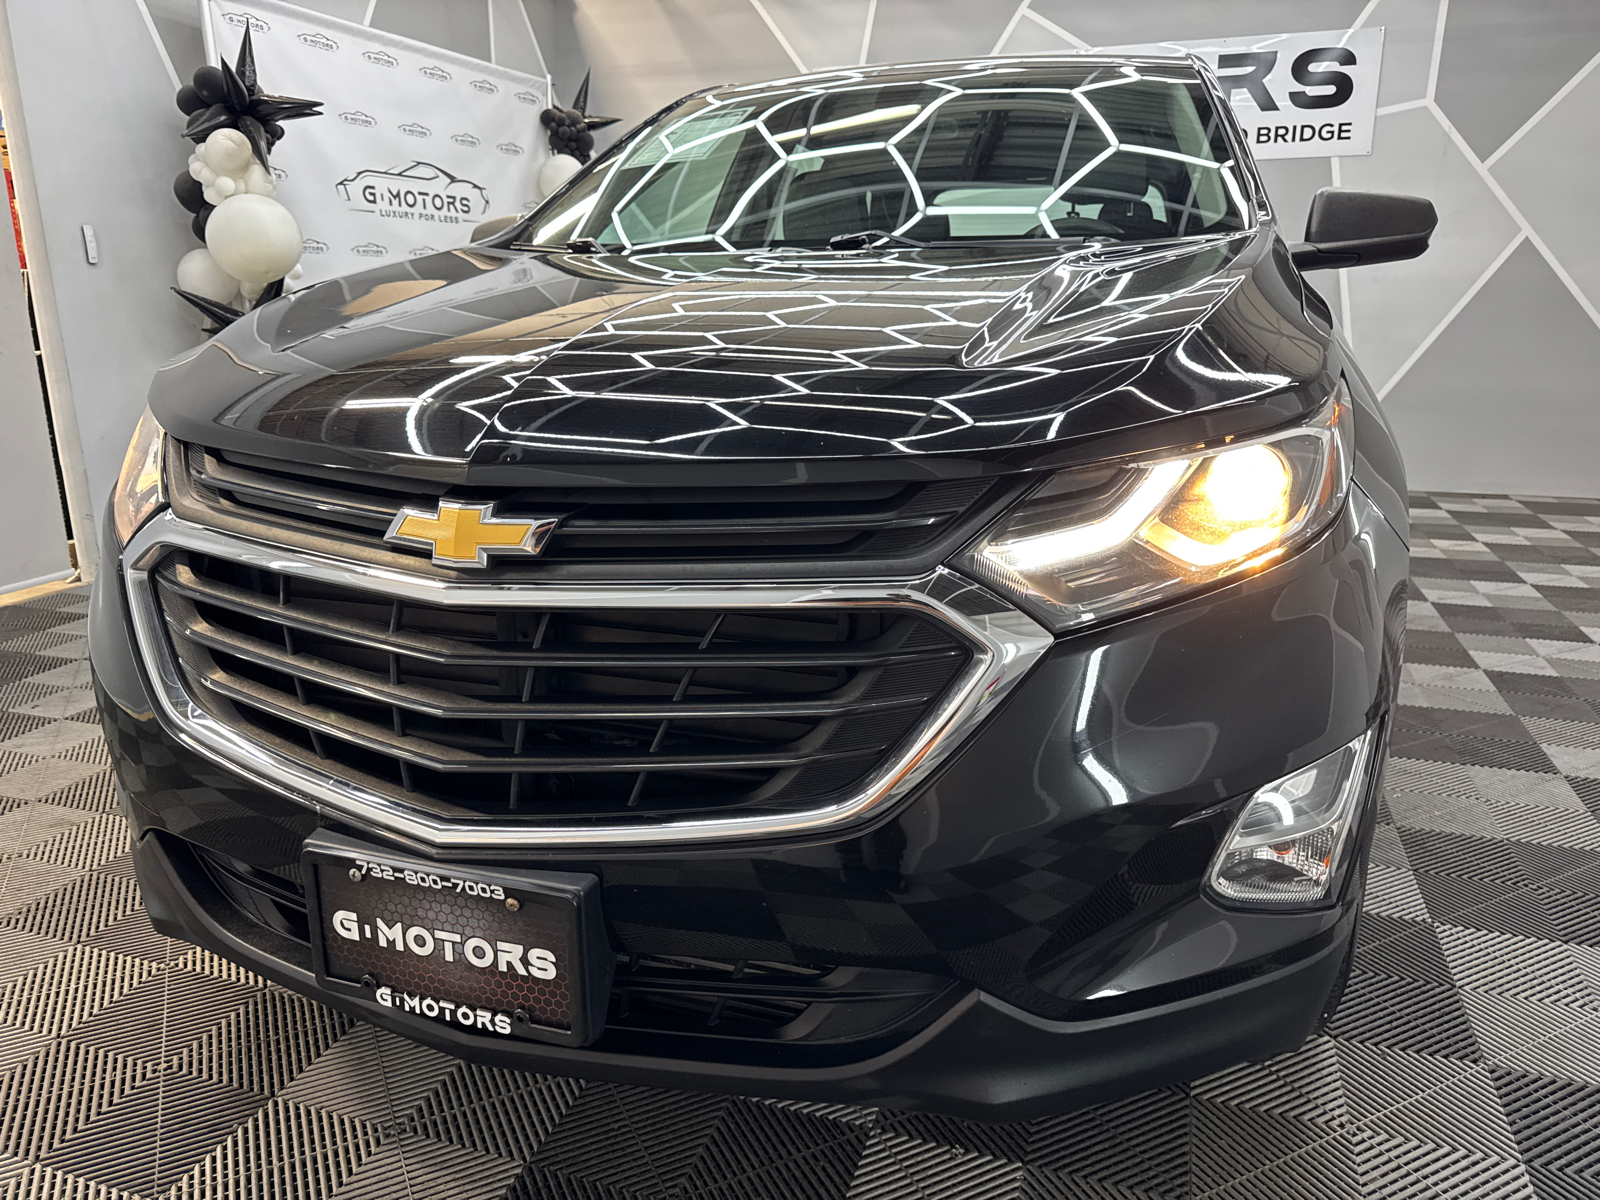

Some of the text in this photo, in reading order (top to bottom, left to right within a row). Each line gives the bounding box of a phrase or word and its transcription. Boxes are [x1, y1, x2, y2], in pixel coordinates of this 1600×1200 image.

[1255, 122, 1353, 145] BRIDGE
[379, 208, 460, 224] LUXURY FOR LESS
[355, 860, 505, 900] 732-800-7003
